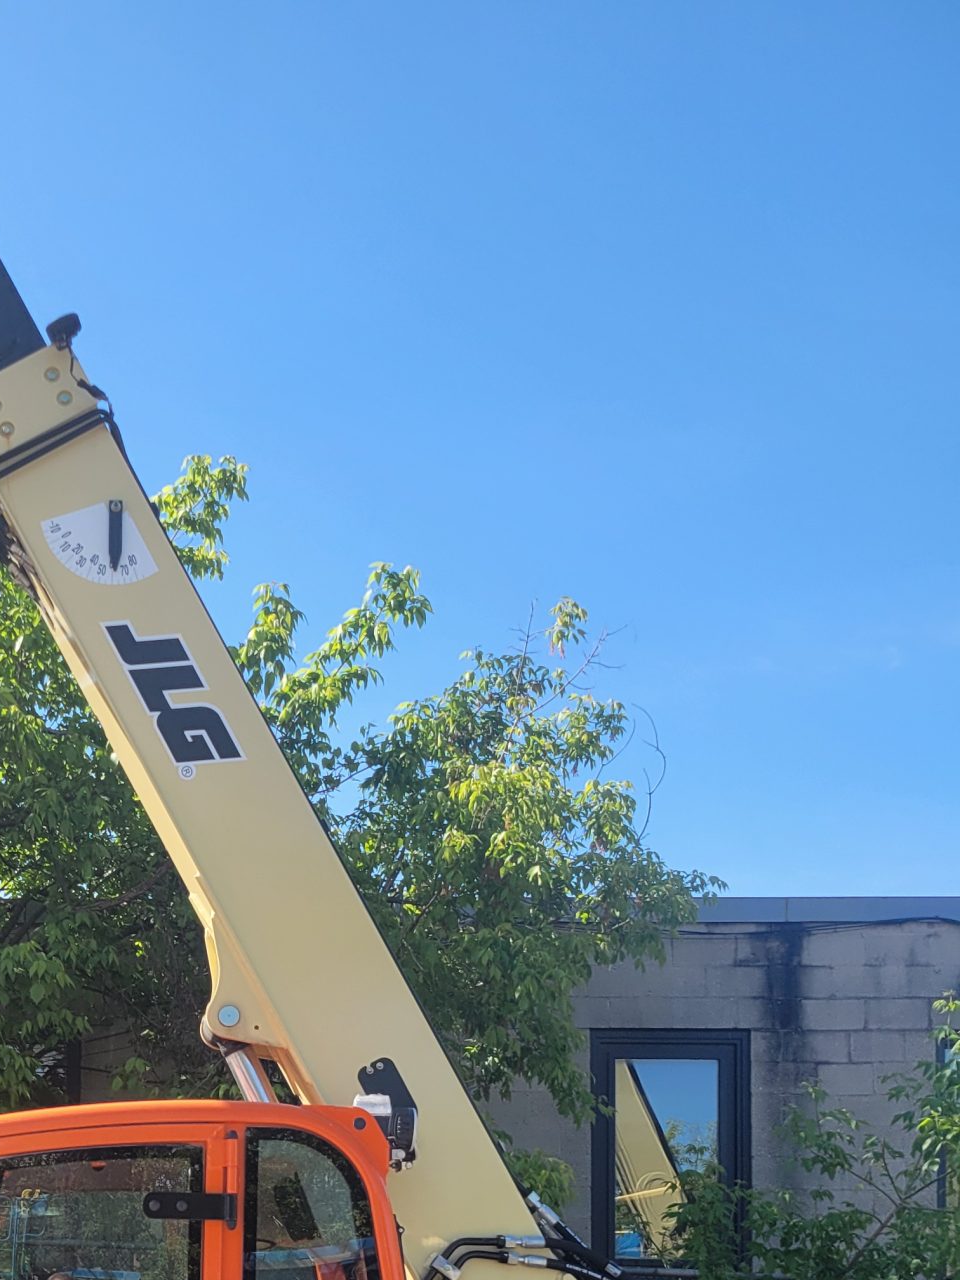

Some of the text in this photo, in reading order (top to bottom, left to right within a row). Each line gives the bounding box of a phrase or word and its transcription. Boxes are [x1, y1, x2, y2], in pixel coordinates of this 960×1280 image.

[60, 541, 72, 553] 10
[72, 543, 84, 555] 20
[76, 555, 87, 568] 30
[90, 553, 100, 566] 40
[128, 554, 138, 567] 80
[97, 563, 107, 576] 50
[120, 564, 130, 576] 70
[102, 622, 245, 765] JLG
